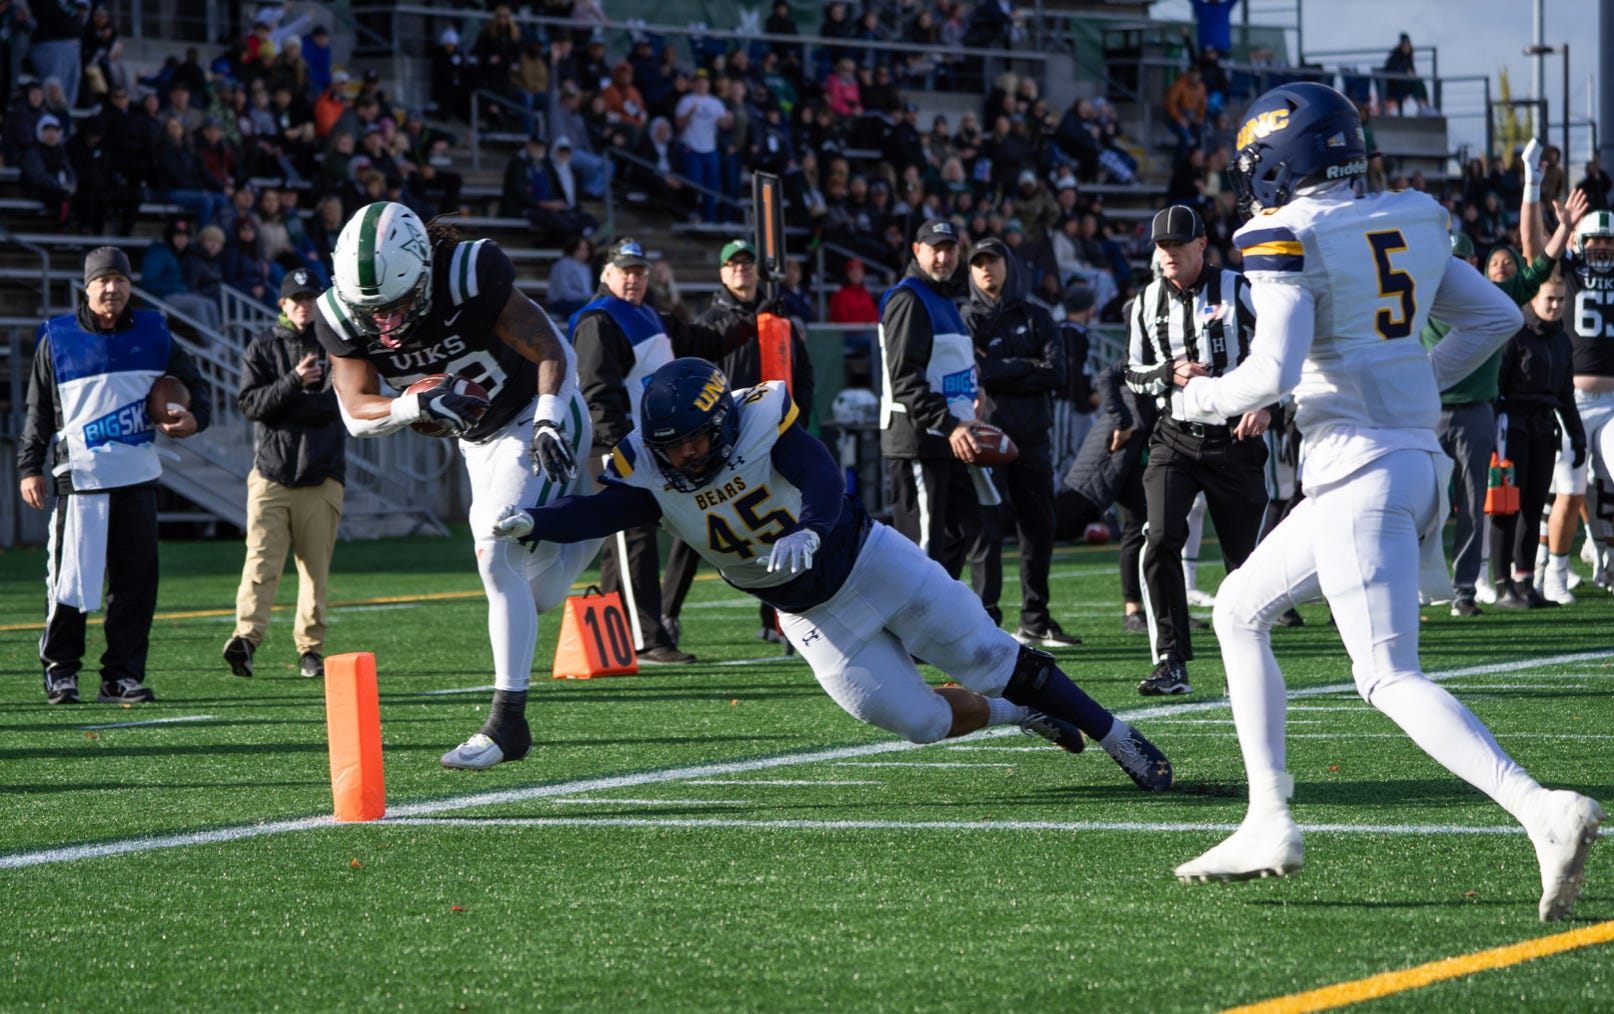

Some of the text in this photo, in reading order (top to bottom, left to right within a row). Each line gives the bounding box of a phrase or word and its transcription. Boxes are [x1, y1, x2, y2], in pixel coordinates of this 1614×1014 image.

[1236, 108, 1290, 151] UNC
[1363, 228, 1418, 341] 5
[1212, 337, 1225, 354] H
[693, 369, 728, 412] UNC
[694, 476, 747, 511] BEARS
[705, 483, 800, 560] 45
[584, 605, 632, 669] 10
